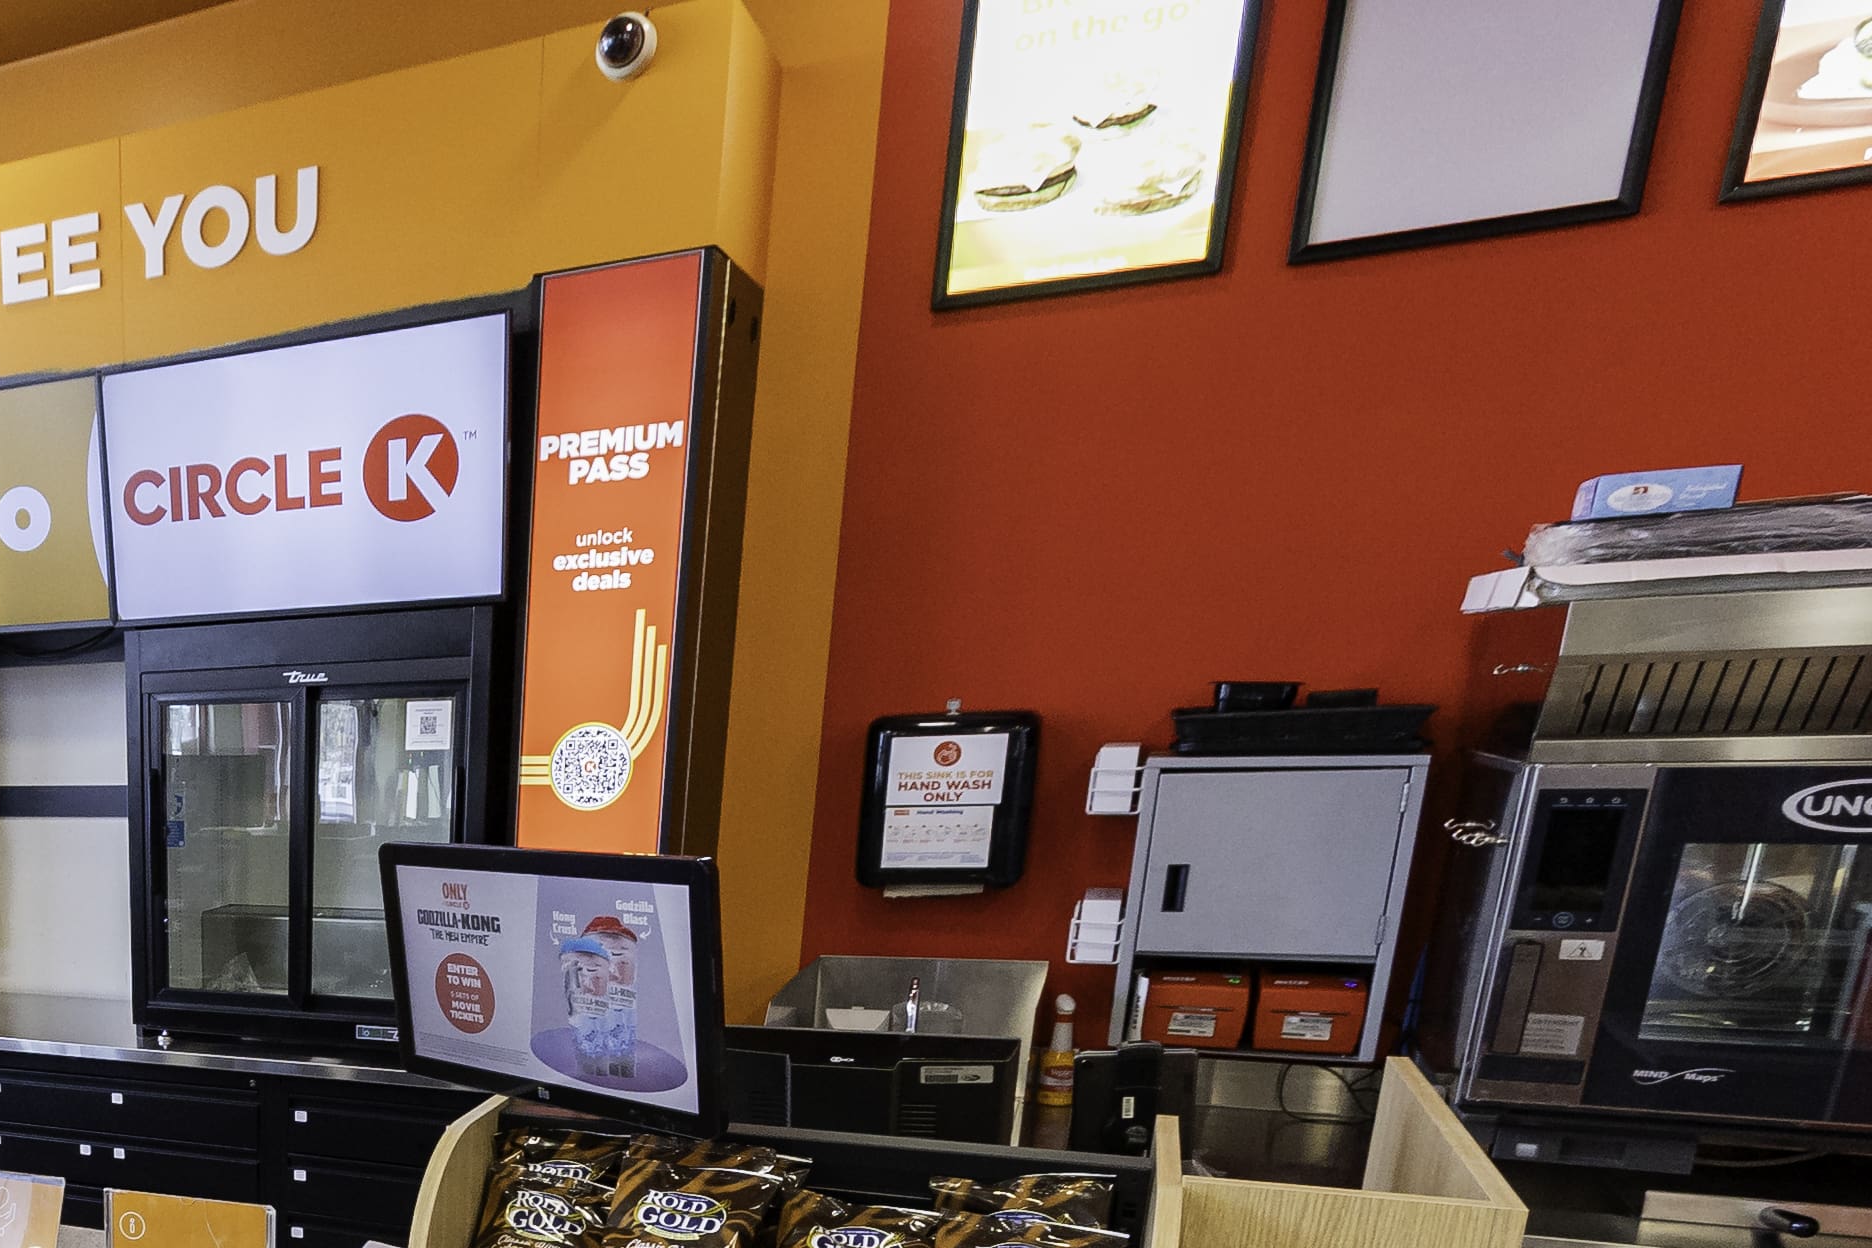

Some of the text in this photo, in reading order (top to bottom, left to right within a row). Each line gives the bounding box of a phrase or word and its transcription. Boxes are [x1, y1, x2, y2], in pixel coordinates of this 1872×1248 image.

[123, 165, 321, 280] YOU
[540, 420, 684, 461] PREMIUM
[124, 431, 454, 526] CIRCLE K
[569, 452, 649, 485] PASS
[576, 527, 633, 547] unlock
[553, 547, 654, 571] exclusive
[572, 570, 631, 592] deals
[898, 772, 923, 780] THIS
[898, 780, 992, 791] HAND WASH
[924, 792, 963, 802] ONLY
[442, 882, 468, 900] ONLY
[447, 963, 479, 976] ENTER
[447, 975, 482, 988] TO WIN
[450, 1010, 484, 1024] TICKETS
[452, 1000, 481, 1013] MOVIE
[647, 1189, 708, 1213] ROLD
[508, 1209, 584, 1236] GOLD
[637, 1206, 721, 1236] GOLD
